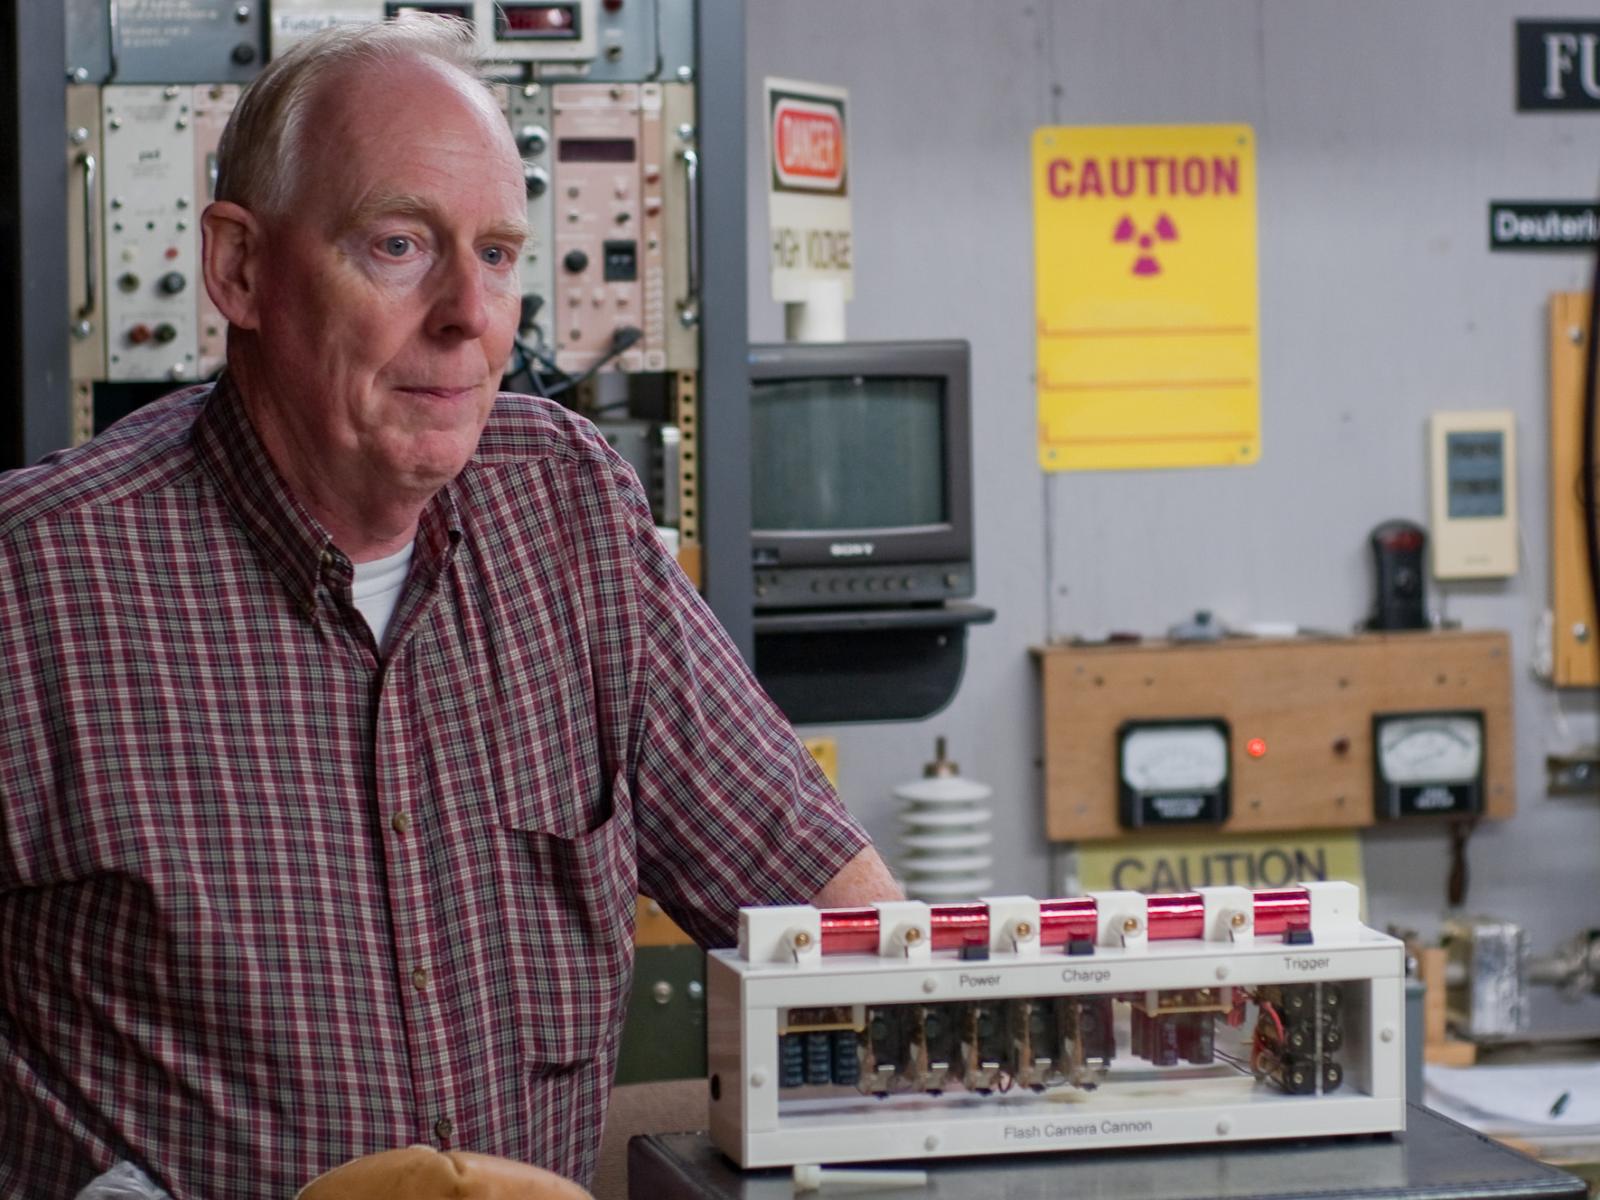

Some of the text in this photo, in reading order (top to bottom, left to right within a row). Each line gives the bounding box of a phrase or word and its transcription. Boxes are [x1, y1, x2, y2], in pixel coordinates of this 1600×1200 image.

[1047, 156, 1239, 198] CAUTION
[1111, 848, 1328, 893] CAUTION
[1283, 956, 1331, 972] Trigger
[959, 973, 1002, 988] Power
[1062, 968, 1111, 984] Charge
[1004, 1119, 1153, 1140] Flash Camera Cannon
